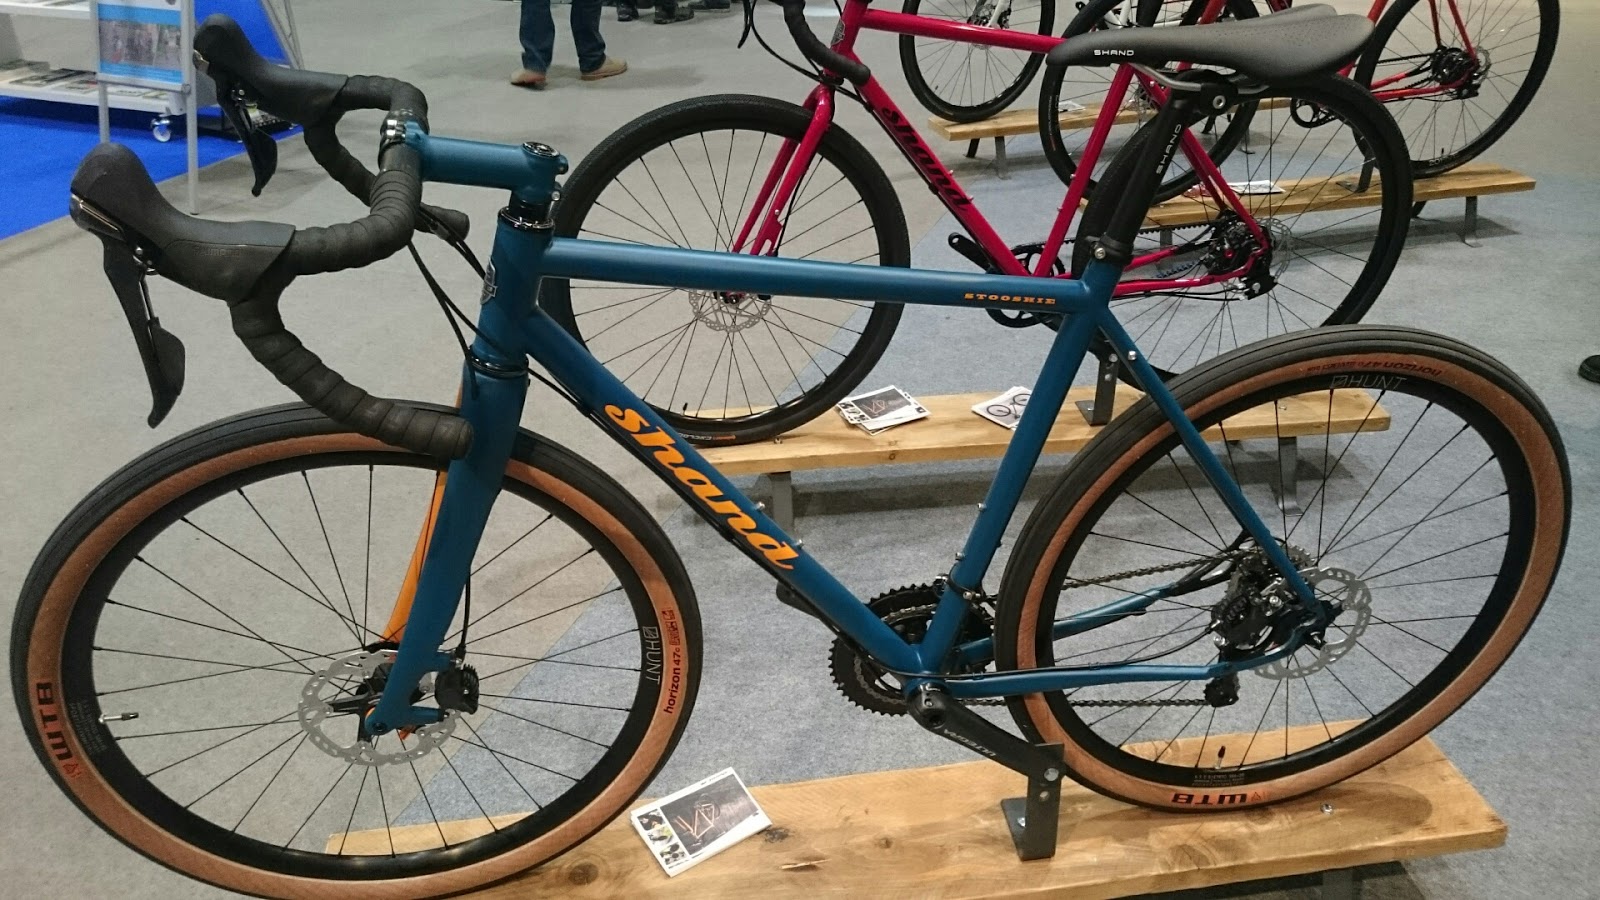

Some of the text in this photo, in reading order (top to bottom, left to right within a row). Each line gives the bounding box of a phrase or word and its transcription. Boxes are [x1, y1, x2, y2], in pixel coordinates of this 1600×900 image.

[1155, 123, 1182, 174] SHAND
[963, 292, 1056, 305] STOOSHIE
[1349, 375, 1408, 389] HUNT
[645, 640, 661, 685] HUNT
[663, 668, 682, 714] horizon
[36, 682, 73, 761] WTB
[1172, 793, 1248, 805] WTB
